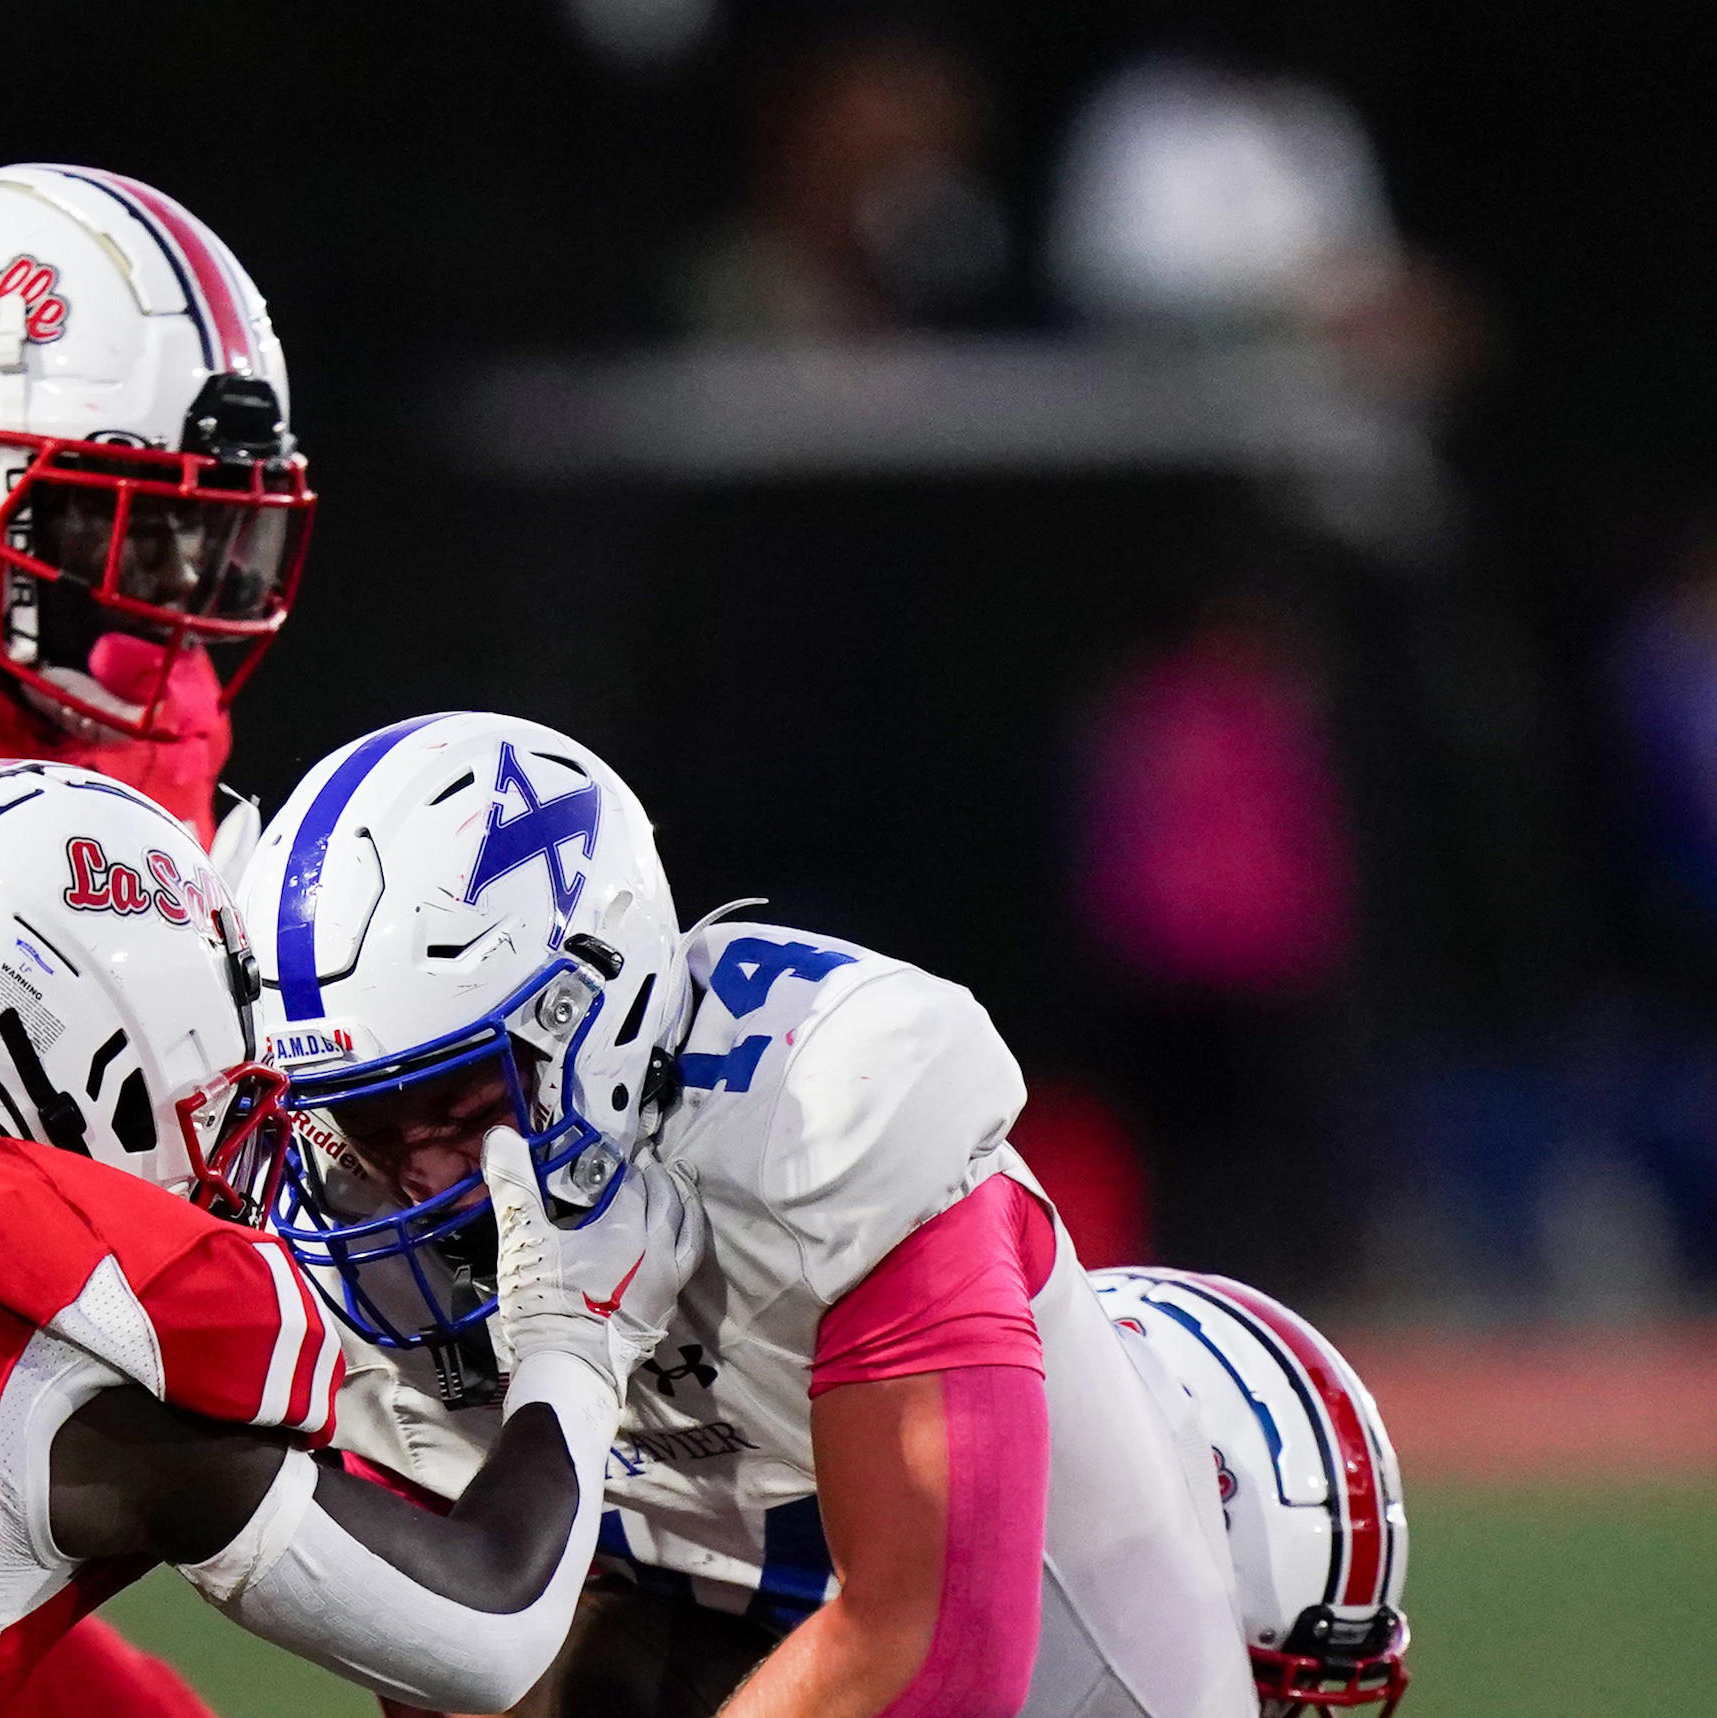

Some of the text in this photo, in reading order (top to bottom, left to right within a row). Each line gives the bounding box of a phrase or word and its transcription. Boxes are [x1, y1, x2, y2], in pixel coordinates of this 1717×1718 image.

[64, 836, 152, 916] La
[464, 741, 602, 951] X
[0, 962, 43, 1002] WARNING
[679, 936, 861, 1094] 14
